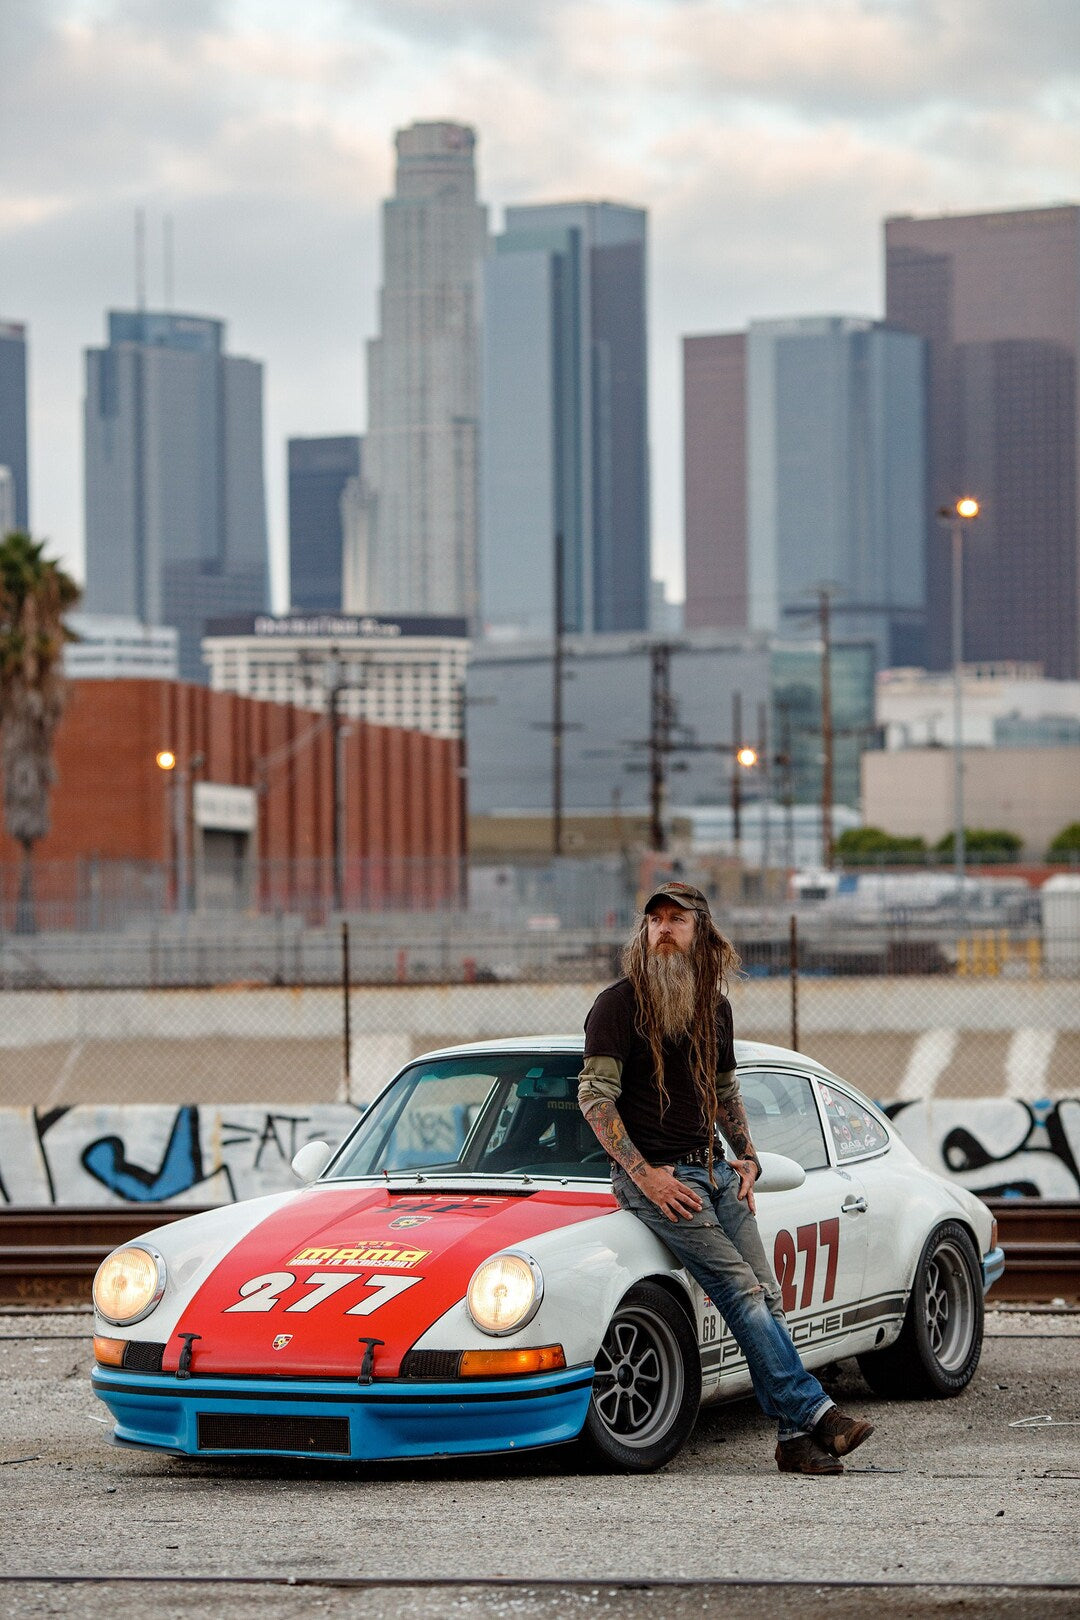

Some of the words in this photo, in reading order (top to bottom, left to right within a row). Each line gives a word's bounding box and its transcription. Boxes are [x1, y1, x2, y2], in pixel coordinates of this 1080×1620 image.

[773, 1217, 840, 1313] 277
[221, 1271, 426, 1316] 277
[703, 1315, 716, 1342] GB
[723, 1314, 841, 1362] PCHE
